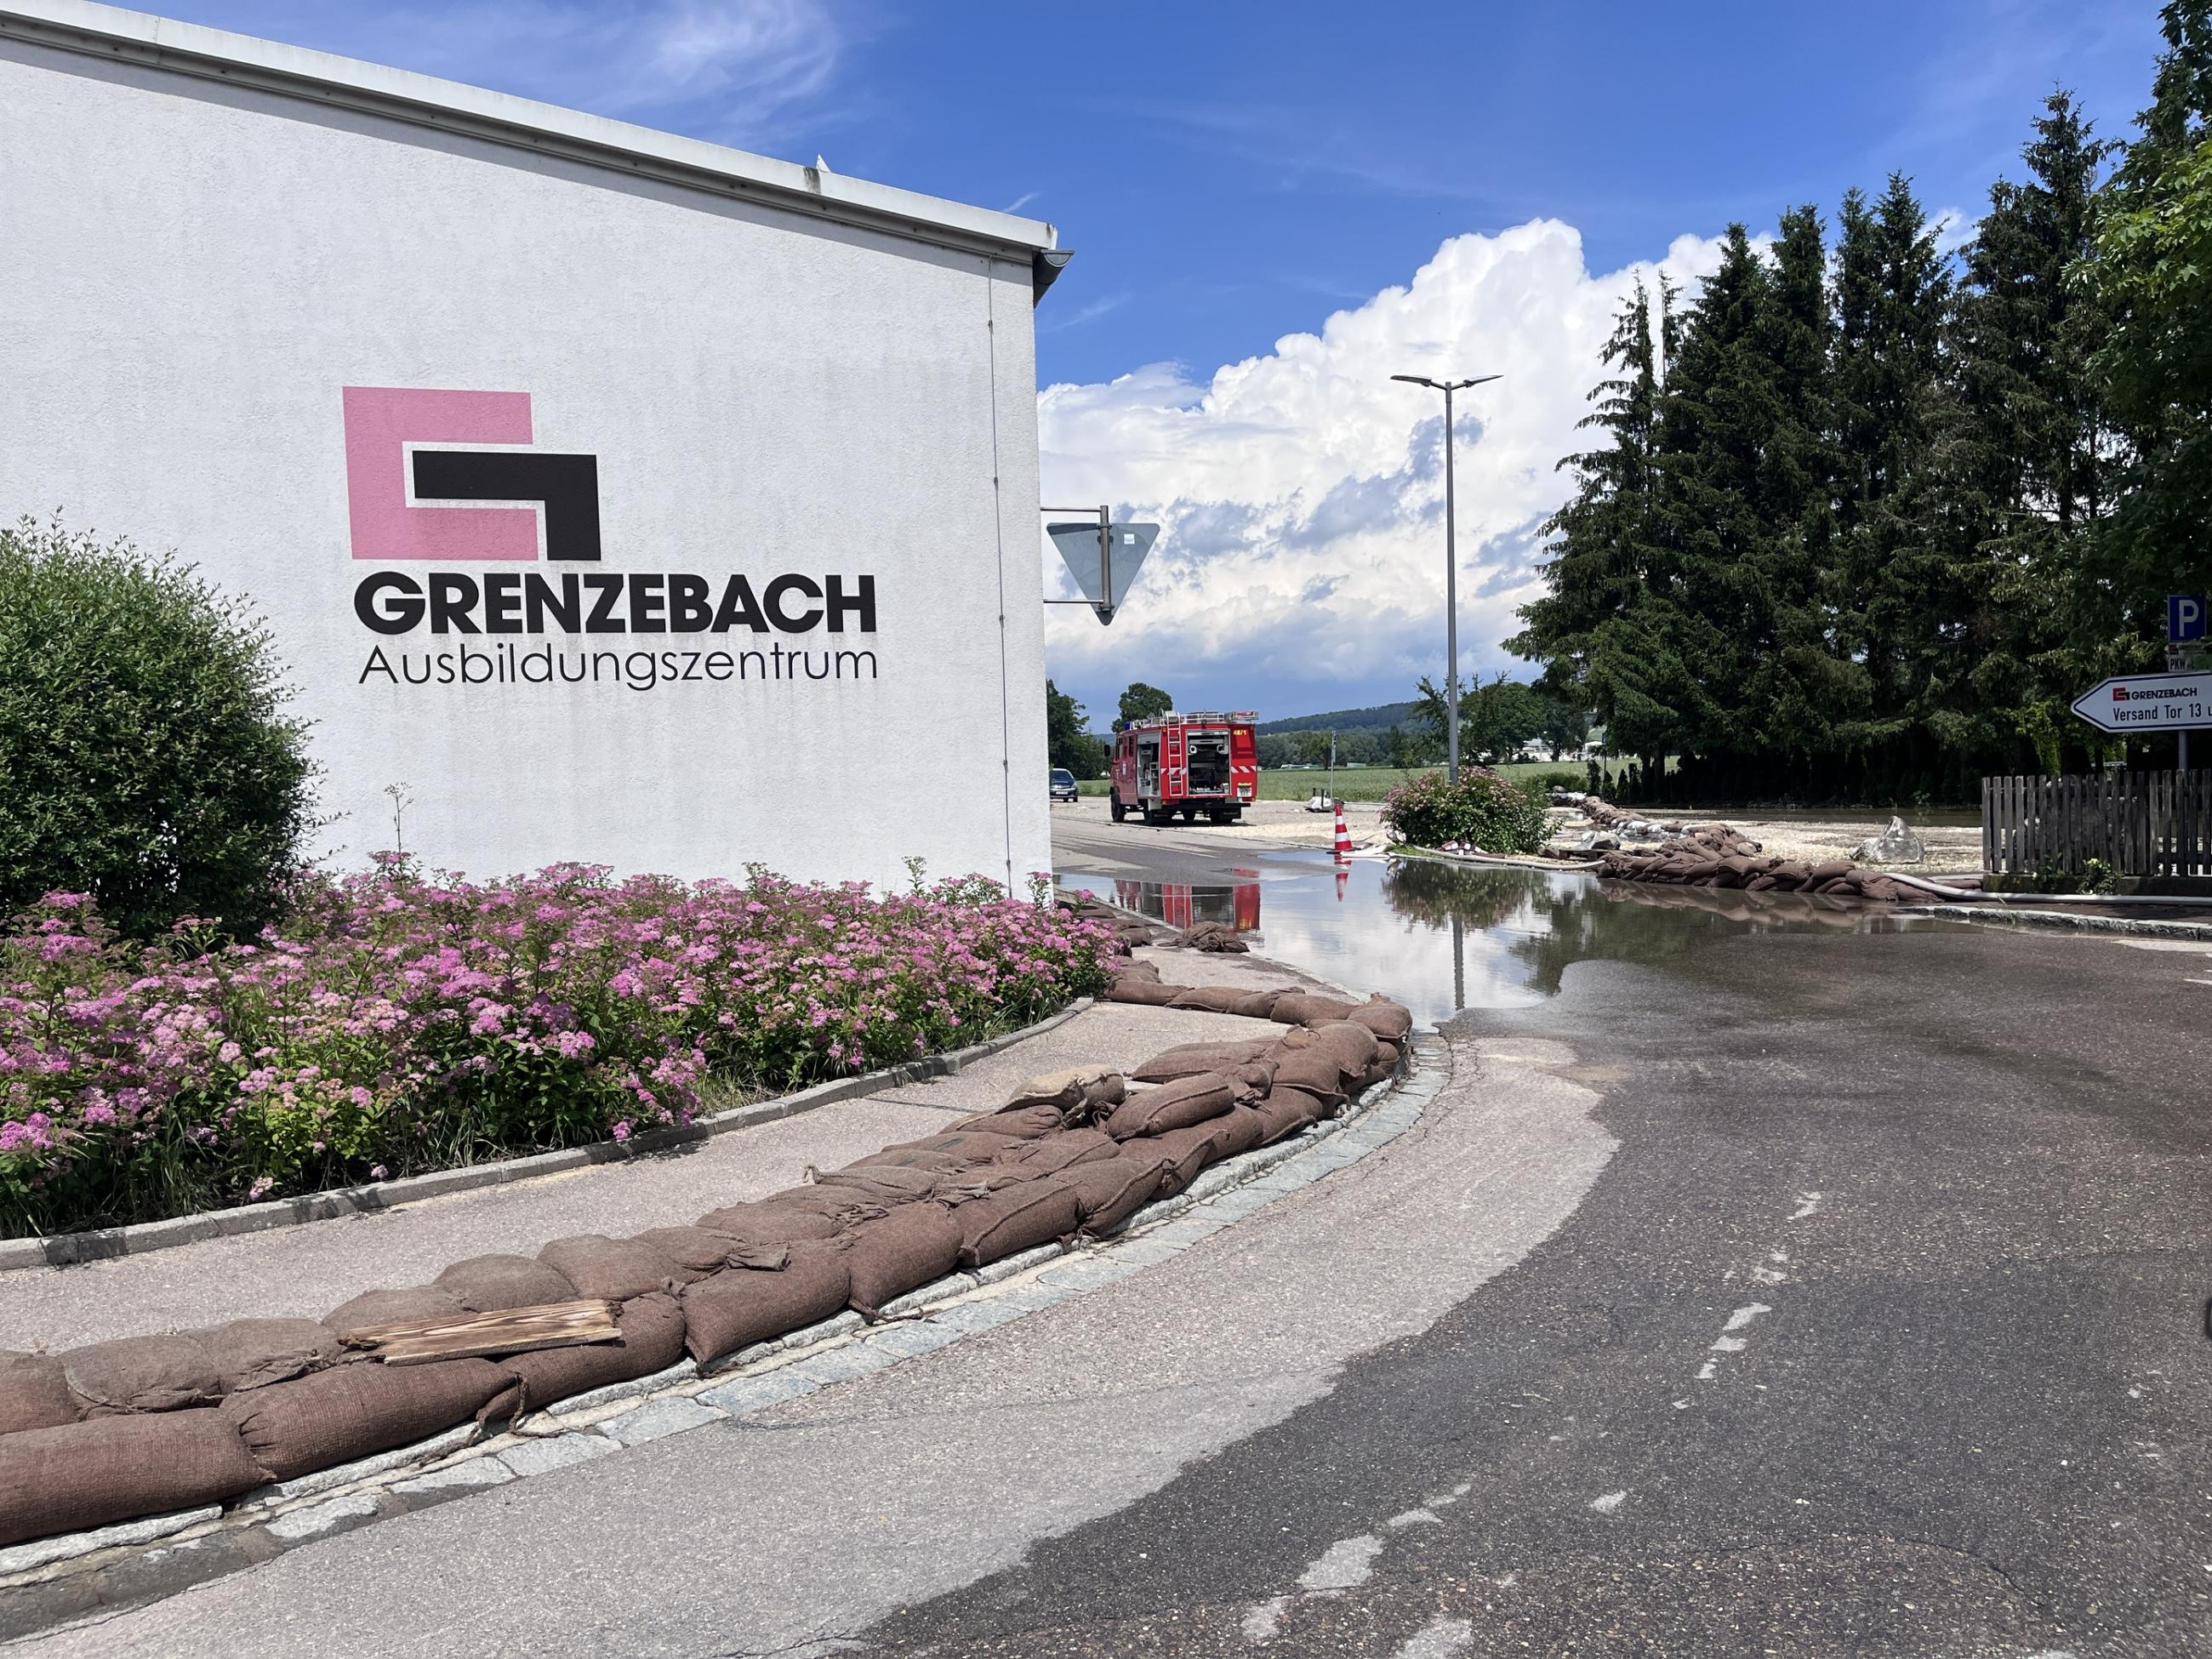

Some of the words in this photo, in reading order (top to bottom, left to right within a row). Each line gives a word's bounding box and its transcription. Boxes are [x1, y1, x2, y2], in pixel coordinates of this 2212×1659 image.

[354, 571, 876, 635] GRENZEBACH
[2179, 599, 2199, 637] P
[359, 642, 877, 690] Ausbildungszentrum
[2169, 658, 2186, 670] PKW
[2131, 687, 2198, 700] GRENZEBACH
[2112, 706, 2158, 721] Versand
[2164, 704, 2183, 719] Tor
[2189, 703, 2202, 717] 13
